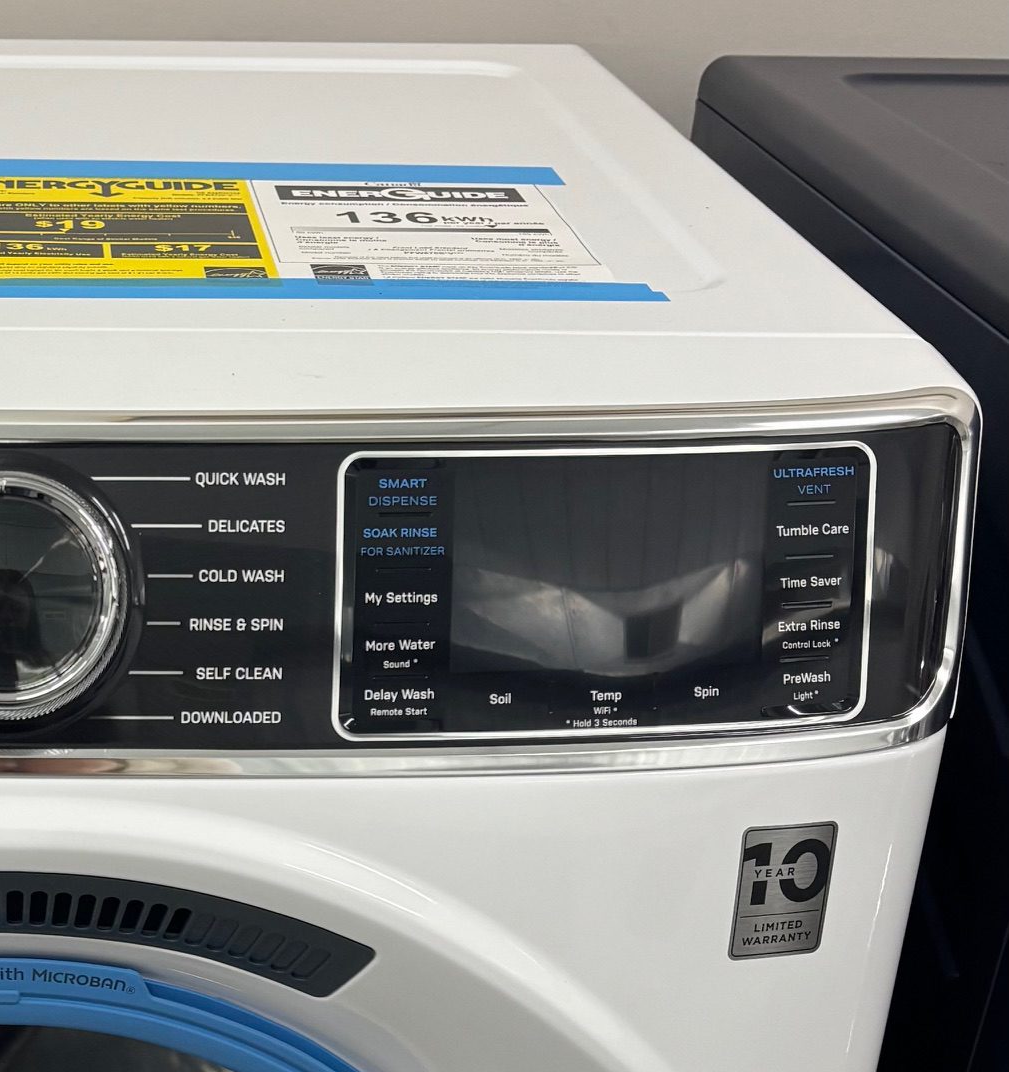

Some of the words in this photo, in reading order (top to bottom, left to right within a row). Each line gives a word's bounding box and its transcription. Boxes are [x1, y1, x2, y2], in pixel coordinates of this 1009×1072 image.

[291, 188, 509, 200] ENERGUIDE
[336, 211, 438, 224] 136
[35, 219, 106, 230] $19
[154, 244, 211, 252] $17
[773, 466, 855, 478] ULTRAFRESH
[195, 472, 239, 487] QUICK
[243, 472, 286, 485] WASH
[378, 478, 427, 489] SMART
[797, 485, 832, 495] VENT
[368, 496, 438, 506] DISPENSE
[208, 519, 286, 533] DELICATES
[776, 524, 819, 537] Tumble
[822, 523, 850, 535] Care
[363, 528, 397, 538] SOAK
[401, 527, 438, 538] RINSE
[360, 547, 384, 557] FOR
[387, 546, 445, 556] SANITIZER
[198, 569, 238, 583] COLD
[242, 569, 285, 583] WASH
[780, 577, 807, 589] Time
[810, 576, 842, 587] Saver
[365, 592, 382, 606] My
[386, 591, 438, 606] Settings
[189, 618, 232, 631] RINSE
[236, 618, 246, 631] &
[250, 618, 284, 631] SPIN
[778, 621, 807, 632] Extra
[810, 620, 841, 631] Rinse
[365, 640, 395, 651] More
[399, 639, 436, 650] Water
[782, 640, 811, 649] Control
[813, 639, 831, 648] Lock
[383, 660, 410, 669] Sound
[196, 667, 231, 680] SELF
[235, 667, 283, 680] CLEAN
[783, 671, 831, 684] PreWash
[364, 689, 398, 702] Delay
[401, 688, 435, 700] Wash
[591, 690, 622, 703] Temp
[694, 686, 720, 699] Spin
[793, 691, 813, 701] Light
[489, 693, 512, 705] Soil
[370, 708, 403, 716] Remote
[405, 707, 428, 716] Start
[593, 706, 611, 715] WiFi
[180, 711, 282, 724] DOWNLOADED
[573, 719, 591, 727] Hold
[594, 719, 600, 727] 3
[602, 718, 638, 727] Seconds
[743, 838, 831, 905] 10
[754, 867, 796, 879] YEAR
[754, 920, 803, 933] LIMITED
[742, 931, 812, 946] WARRANTY
